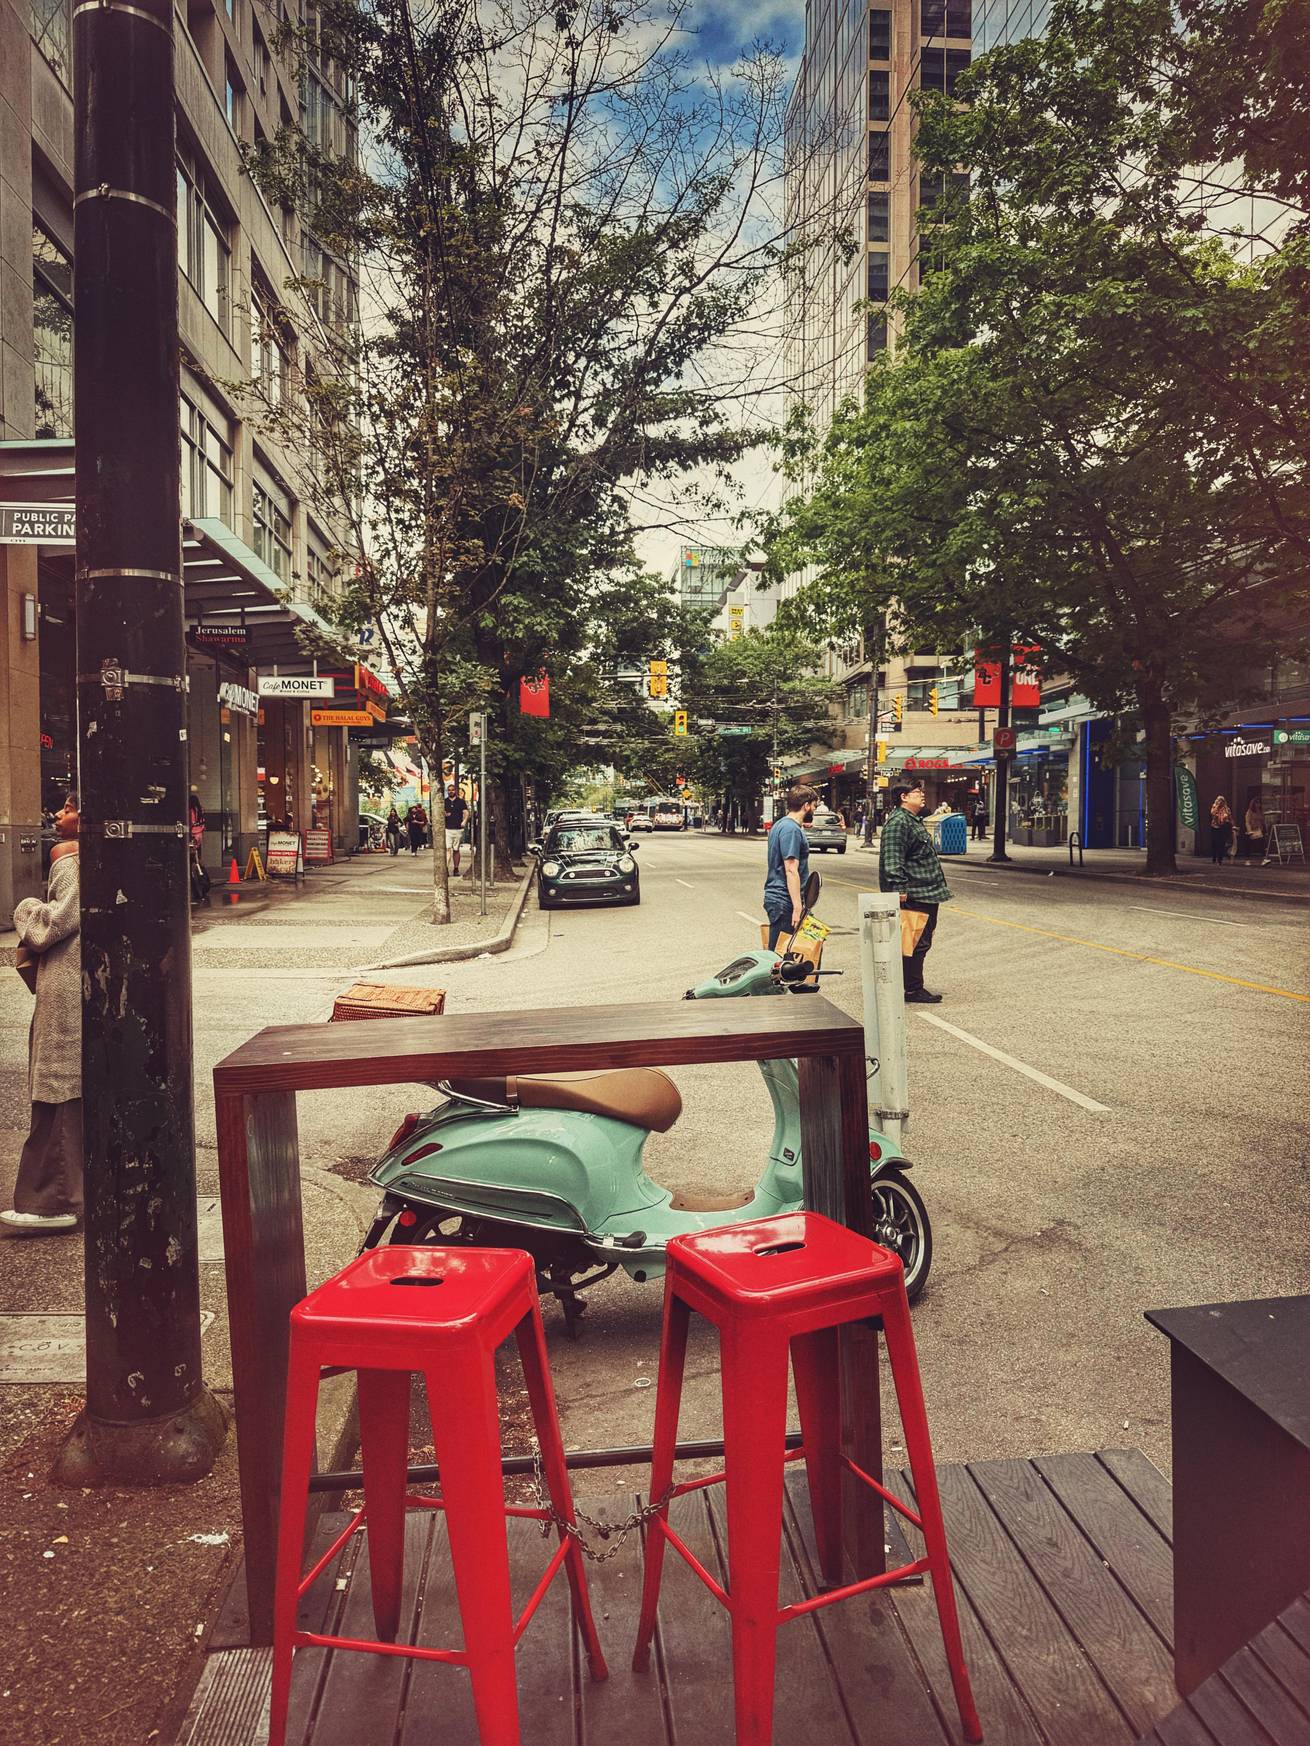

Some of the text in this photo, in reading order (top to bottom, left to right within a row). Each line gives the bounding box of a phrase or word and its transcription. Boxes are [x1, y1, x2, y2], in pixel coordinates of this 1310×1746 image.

[14, 512, 59, 522] PUBLIC
[195, 626, 246, 635] Jerusalem
[195, 635, 247, 643] Shawarma
[281, 680, 324, 690] MONET
[1180, 774, 1194, 826] vitasave
